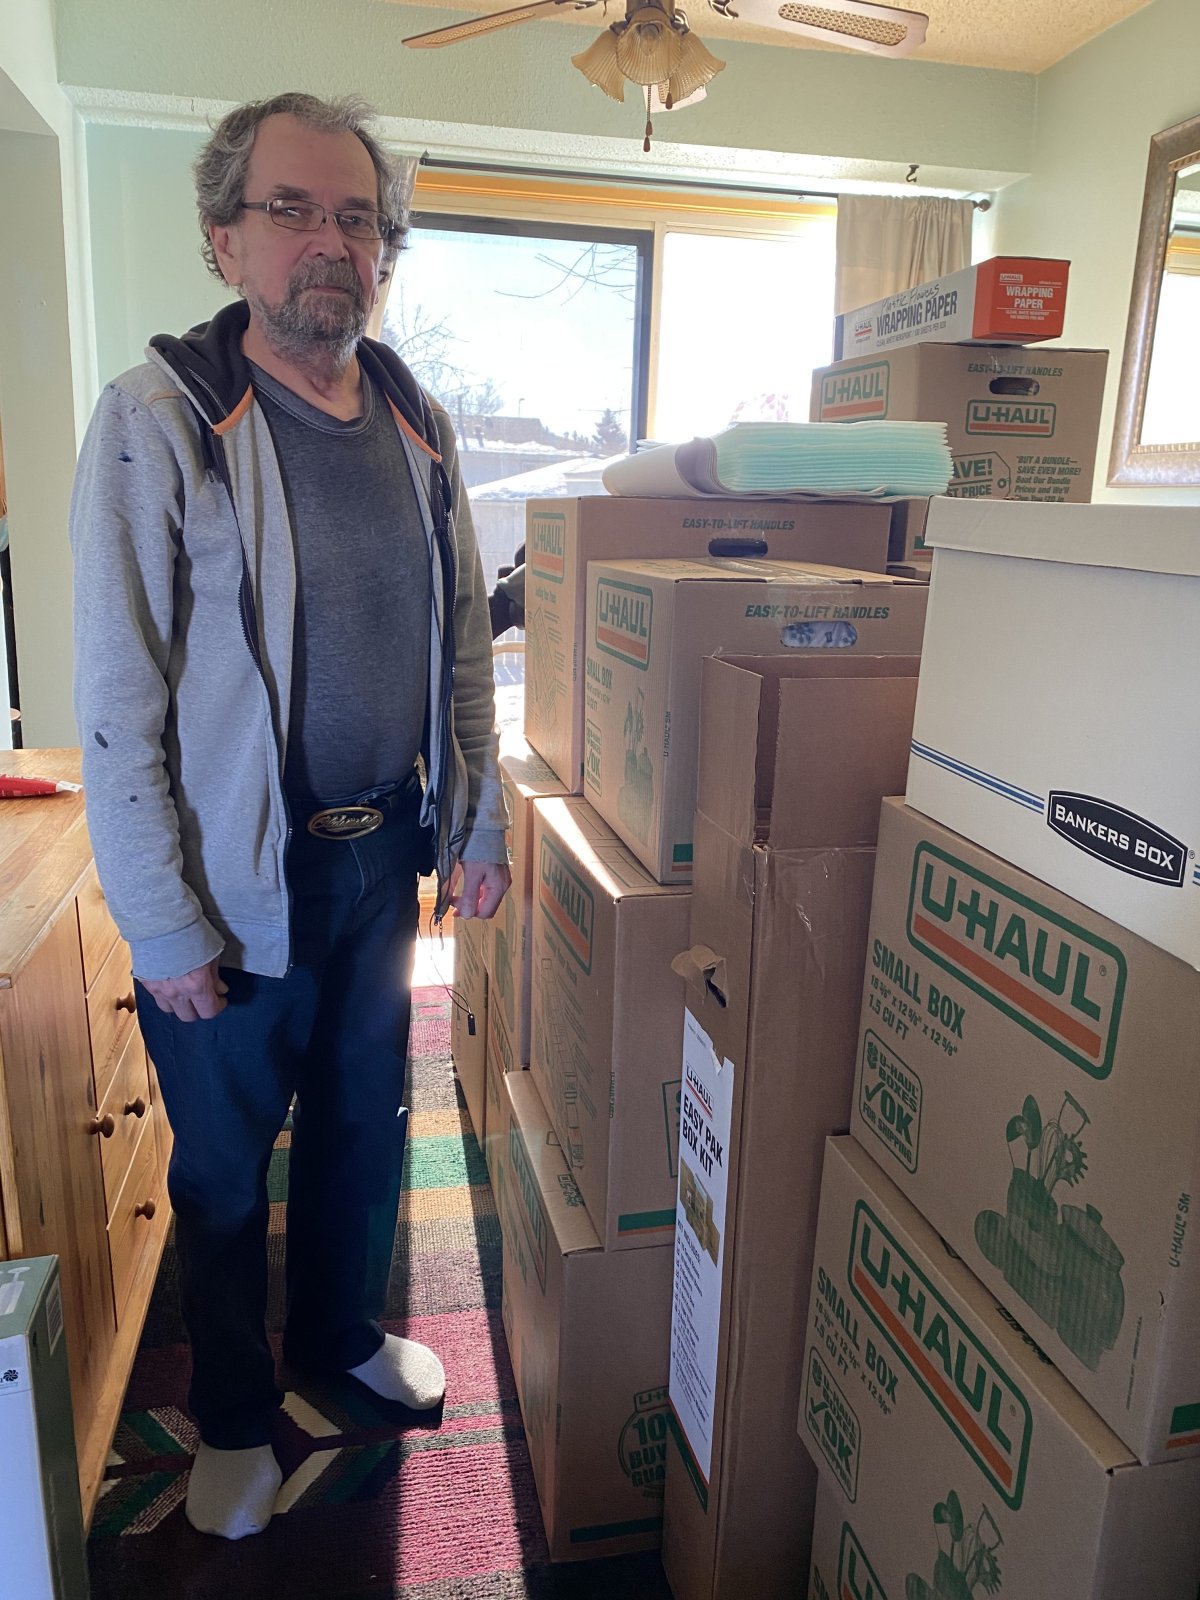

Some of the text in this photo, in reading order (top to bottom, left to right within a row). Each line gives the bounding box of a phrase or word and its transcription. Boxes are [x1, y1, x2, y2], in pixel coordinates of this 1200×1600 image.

[876, 290, 958, 337] WRAPPING PAPER
[1006, 286, 1054, 298] WRAPPING
[1014, 298, 1043, 309] PAPER
[824, 374, 884, 406] U-HAUL
[968, 363, 1064, 377] EASY-TO-LIFT HANDLES
[973, 406, 1050, 424] U-HAUL
[953, 459, 992, 479] AVE!
[962, 484, 992, 498] PRICE
[1015, 485, 1037, 493] Prices
[1017, 465, 1081, 476] SAVE EVEN MORE!
[683, 518, 795, 530] EASY-TO-LIFT HANDLES
[599, 589, 647, 637] U-HAUL
[745, 605, 890, 619] EASY-TO-LIFT HANDLES
[601, 666, 613, 689] BOX
[1055, 803, 1175, 871] BANKERS BOX
[542, 848, 589, 941] U-HAUL
[921, 862, 1101, 1023] U-HAUL
[873, 938, 965, 1040] SMALL BOX
[869, 993, 909, 1040] 1.5 CU FT
[687, 1065, 713, 1113] U-HAUL
[878, 1066, 917, 1113] BOXES
[879, 1051, 918, 1100] U-HAUL
[684, 1093, 723, 1168] EASY PAK
[863, 1101, 912, 1164] FOR SHIPPING
[880, 1088, 913, 1147] OK
[682, 1119, 714, 1178] BOX KIT
[1178, 1192, 1191, 1214] SM
[817, 1265, 899, 1405] SMALL BOX
[825, 1334, 838, 1358] CU
[837, 1352, 850, 1377] FT
[860, 1221, 1013, 1455] U-HAUL
[632, 1413, 667, 1446] 10
[823, 1409, 853, 1478] OK
